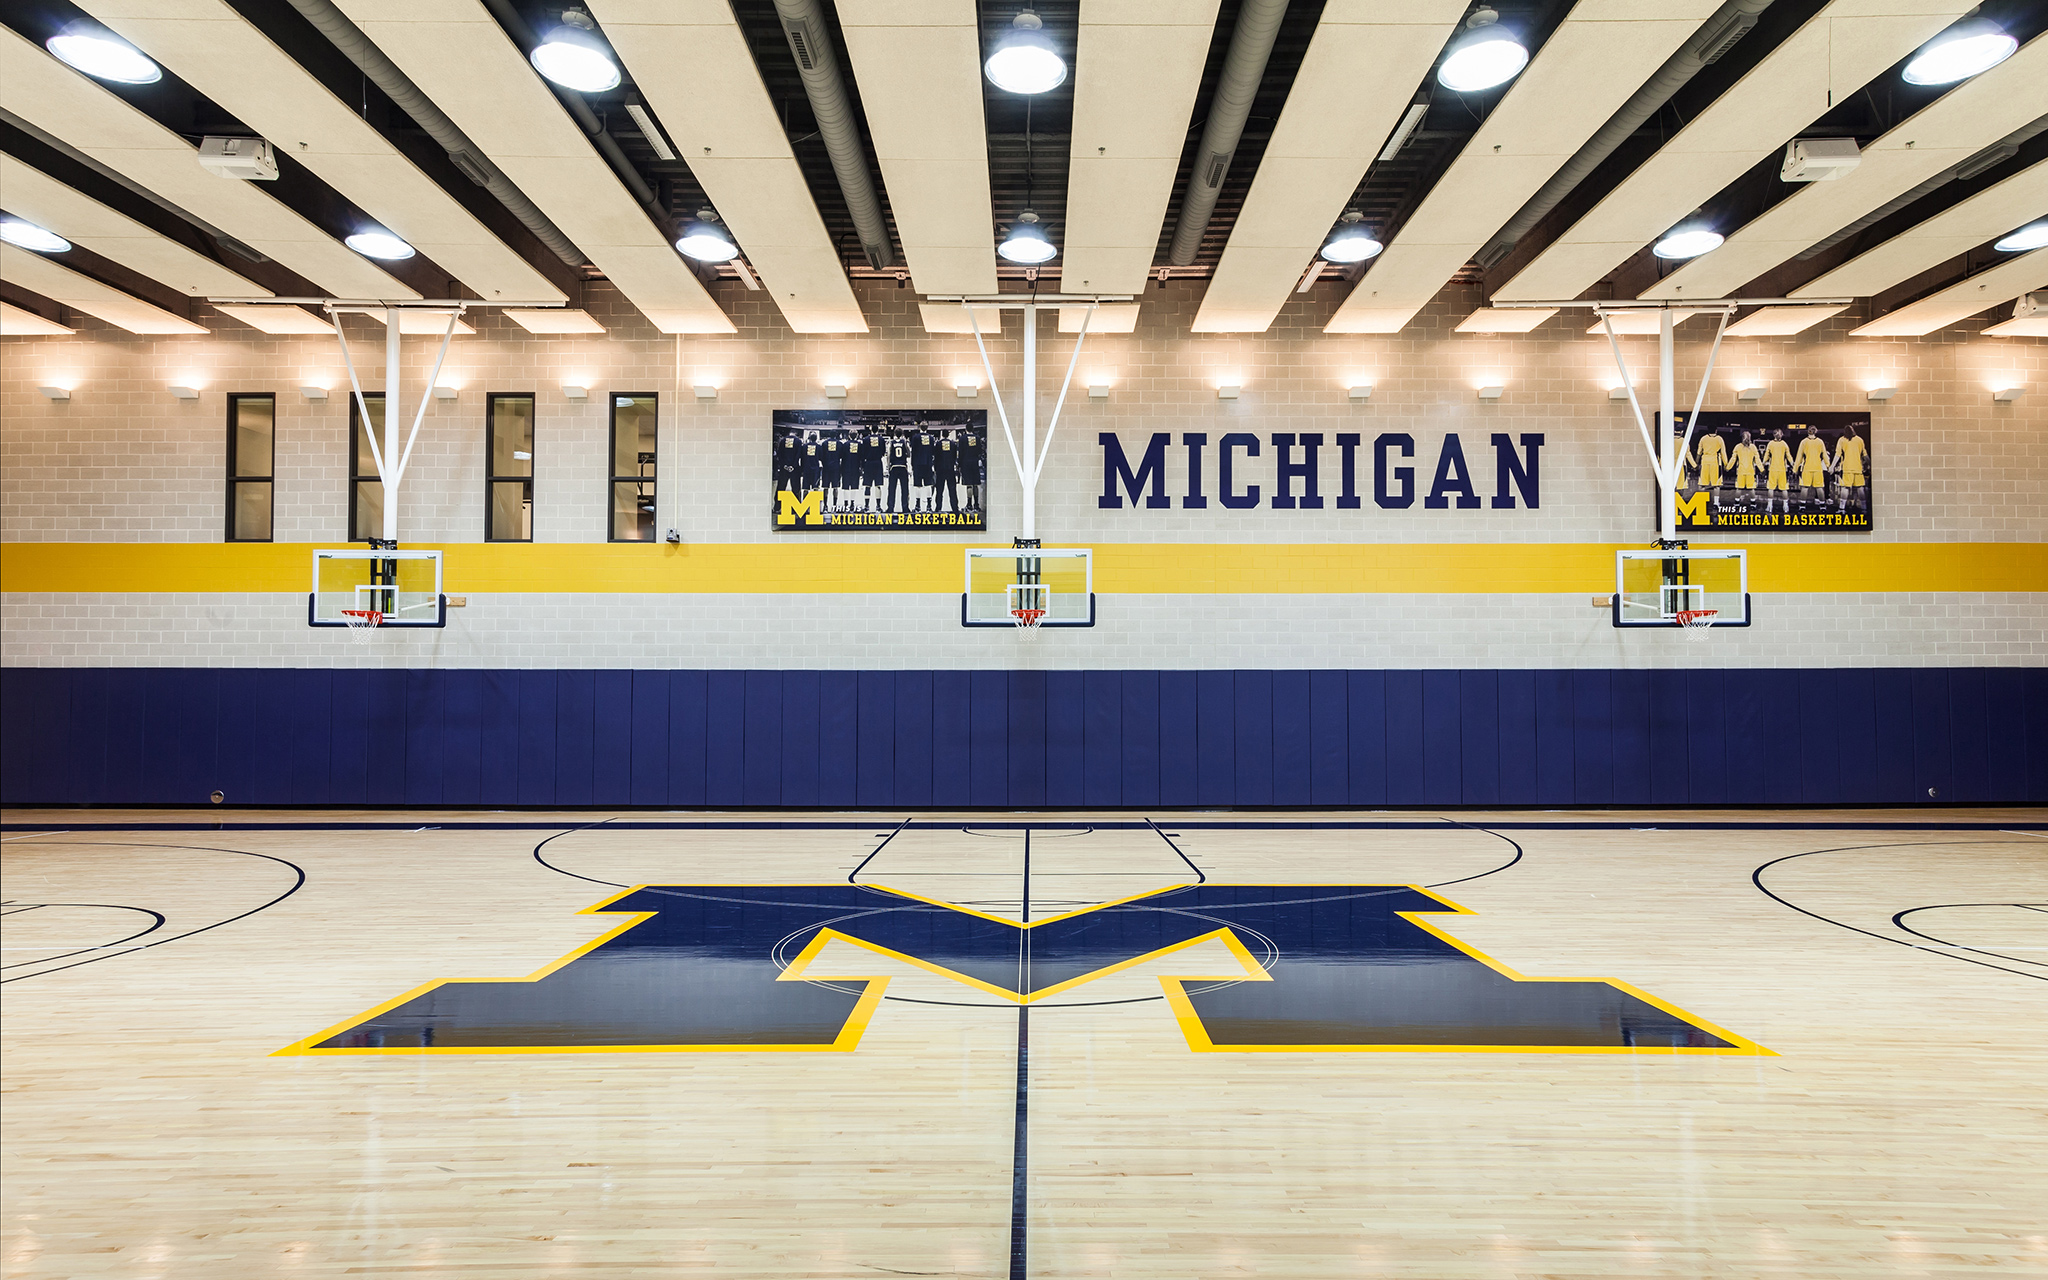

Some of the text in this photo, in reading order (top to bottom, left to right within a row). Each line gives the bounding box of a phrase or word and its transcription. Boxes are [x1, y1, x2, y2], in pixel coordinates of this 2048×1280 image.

[1098, 432, 1545, 509] MICHIGAN
[831, 513, 981, 525] MICHIGAN BASKETBALL
[1717, 514, 1868, 526] MICHIGAN BASKETBALL
[267, 884, 1782, 1057] M
